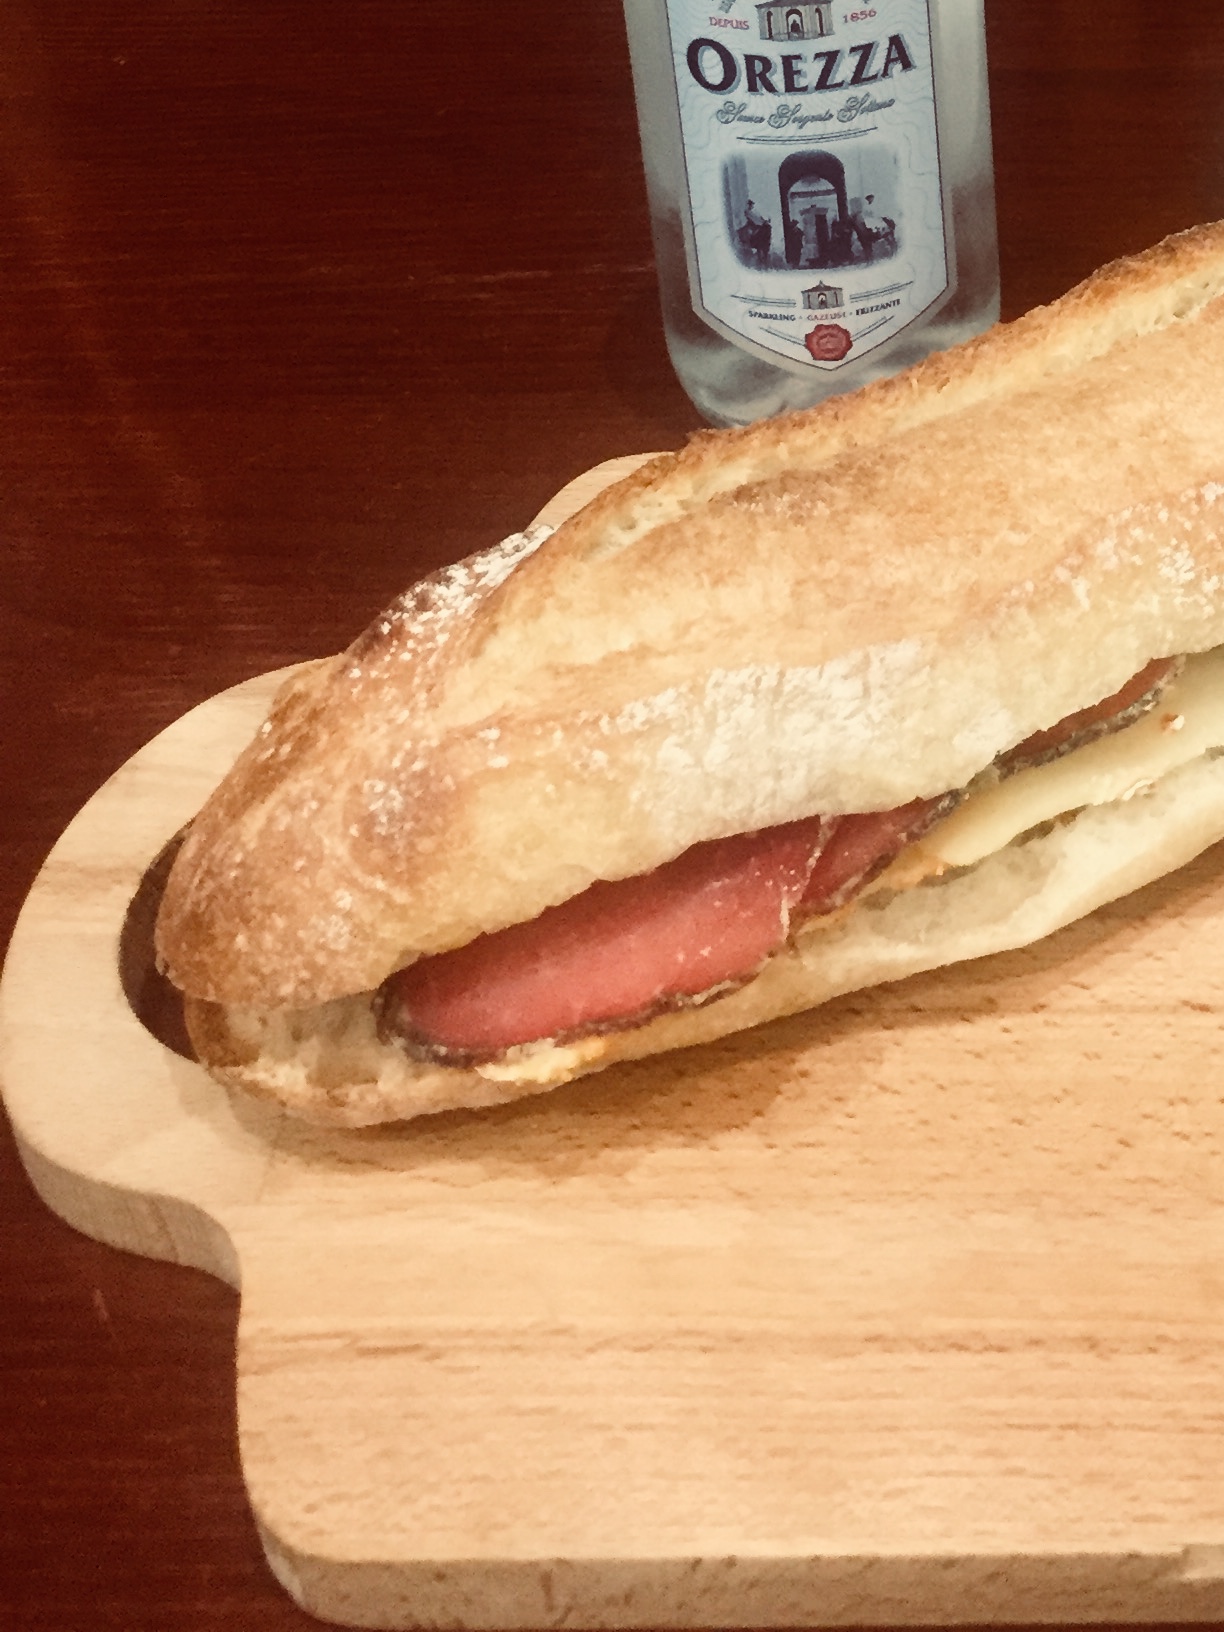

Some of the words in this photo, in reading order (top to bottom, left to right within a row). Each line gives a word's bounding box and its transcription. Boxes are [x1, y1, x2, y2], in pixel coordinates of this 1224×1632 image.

[708, 16, 750, 31] DEPUIS
[842, 8, 877, 24] 1856
[686, 33, 917, 97] OREZZA
